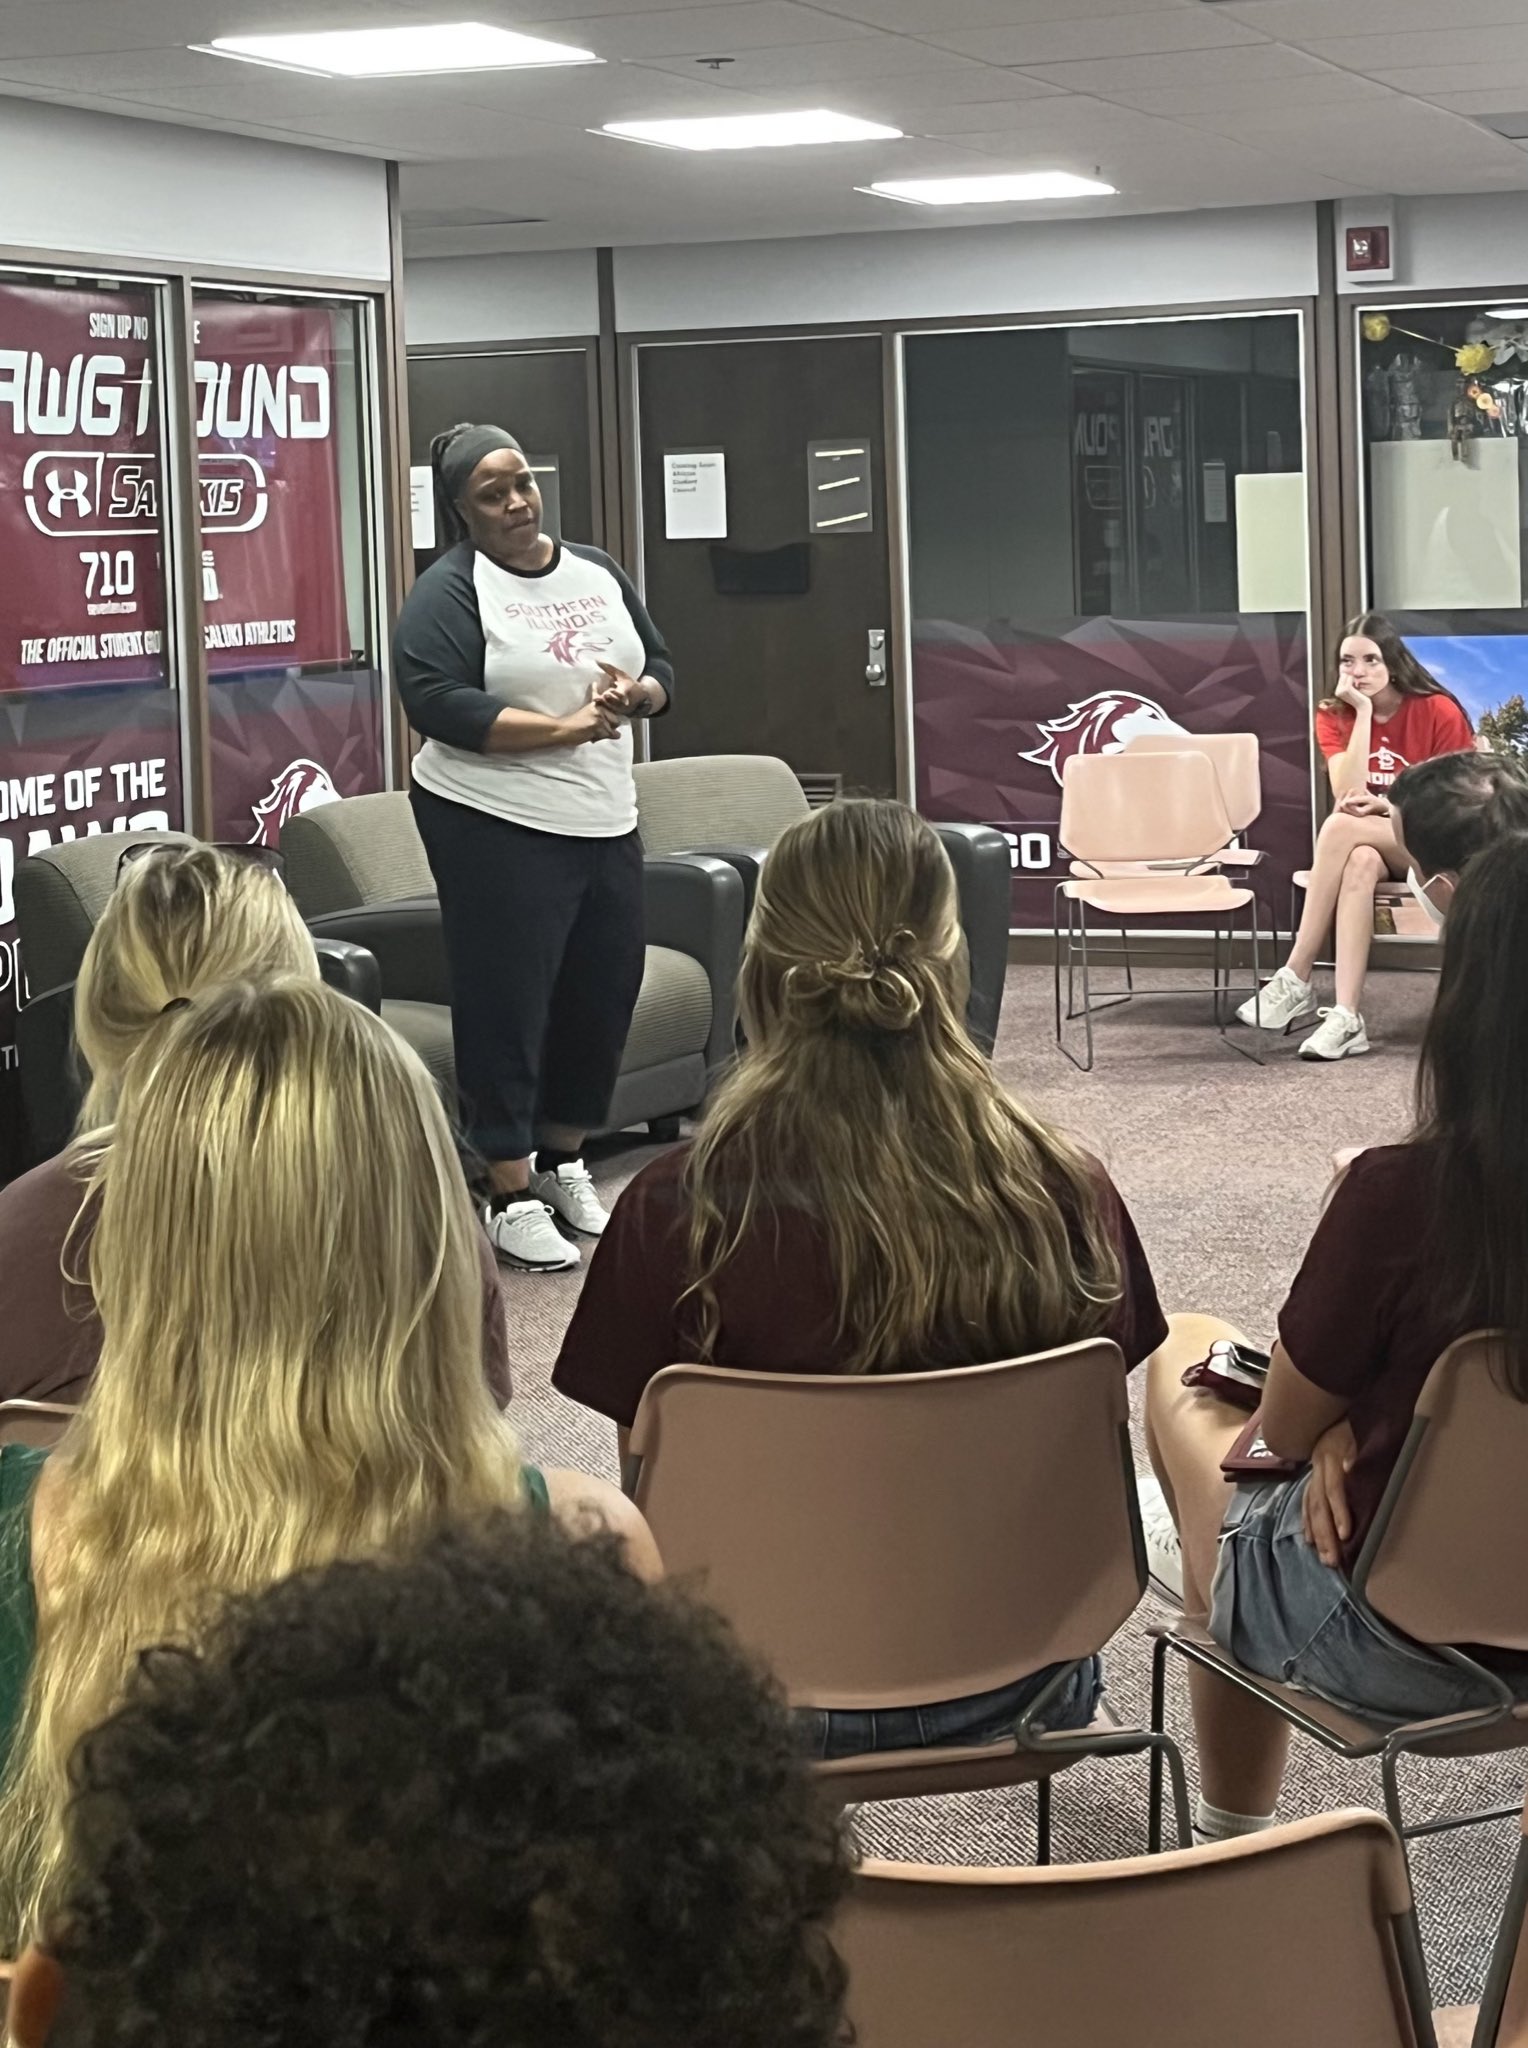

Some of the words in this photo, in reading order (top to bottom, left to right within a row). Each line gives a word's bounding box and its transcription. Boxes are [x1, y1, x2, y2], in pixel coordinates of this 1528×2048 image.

[89, 312, 115, 338] SIGN
[117, 314, 132, 339] UP
[133, 316, 148, 341] NO
[0, 349, 126, 436] AWG
[79, 550, 135, 600] 710
[504, 594, 608, 619] SOUTHERN
[525, 610, 607, 632] ILLINOIS
[21, 638, 47, 665] THE
[46, 634, 99, 663] OFFICIAL
[99, 631, 144, 659] STUDENT
[203, 623, 244, 650] SALUKI
[244, 619, 297, 646] ATHLETICS
[63, 766, 103, 811] OF
[109, 758, 167, 803] THE
